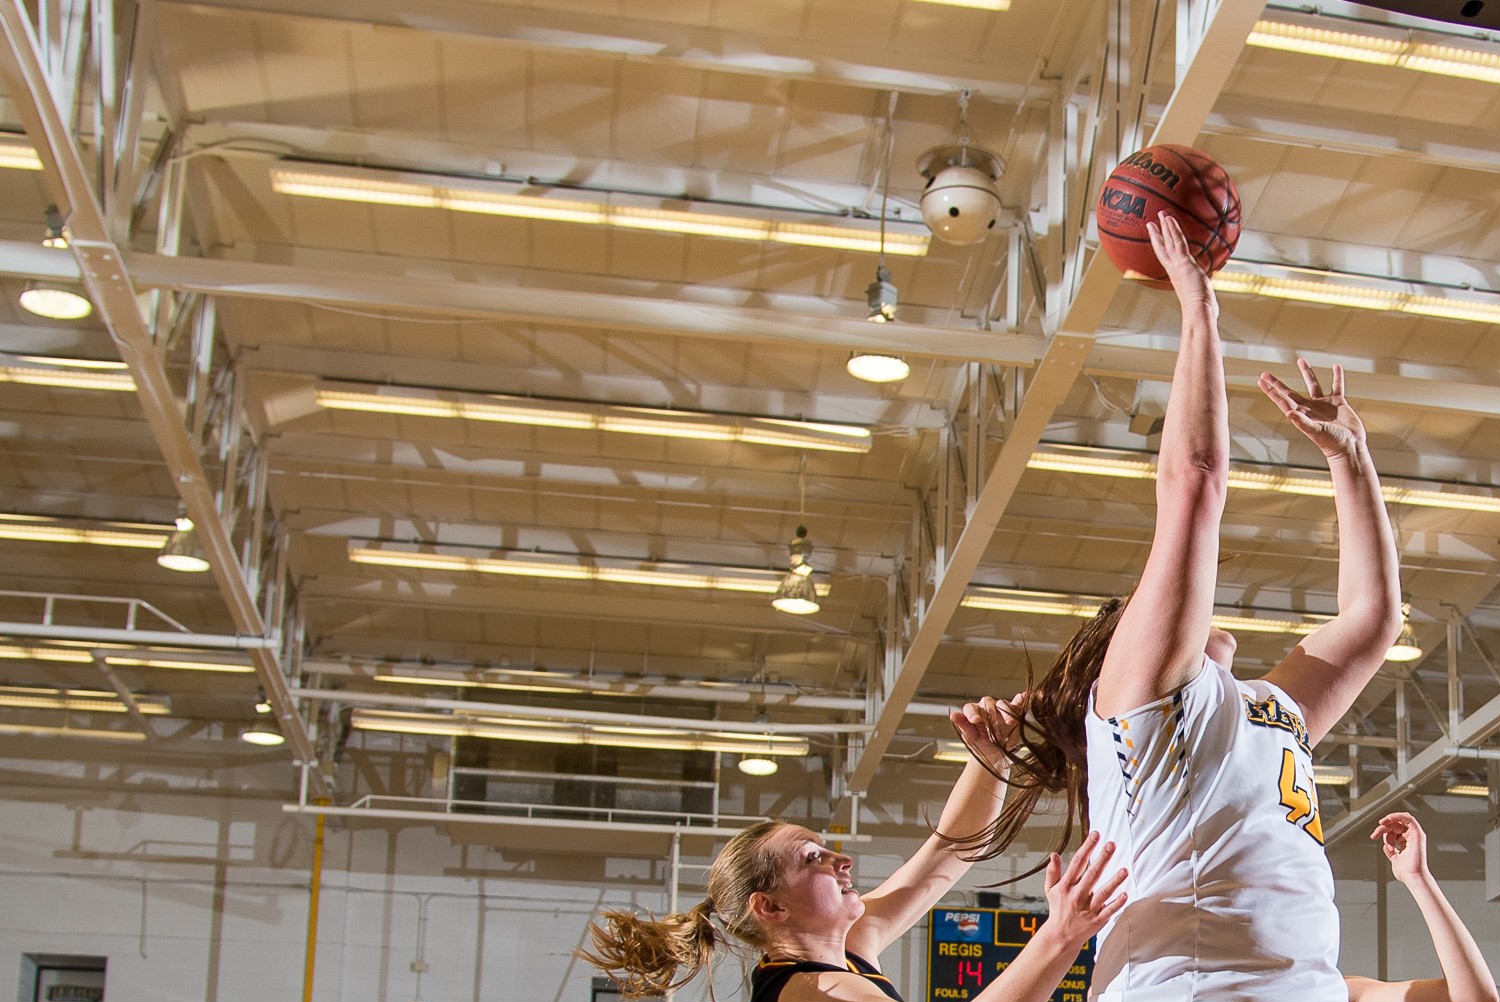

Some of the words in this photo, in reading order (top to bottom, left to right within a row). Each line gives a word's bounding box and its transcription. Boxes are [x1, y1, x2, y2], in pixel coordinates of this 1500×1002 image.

[1124, 150, 1180, 190] ilson
[1100, 186, 1147, 220] NCAA
[945, 912, 980, 923] PEPSI
[939, 943, 983, 957] REGIS
[958, 961, 982, 986] 14
[935, 988, 968, 998] FOULS
[1062, 993, 1082, 1002] PTS
